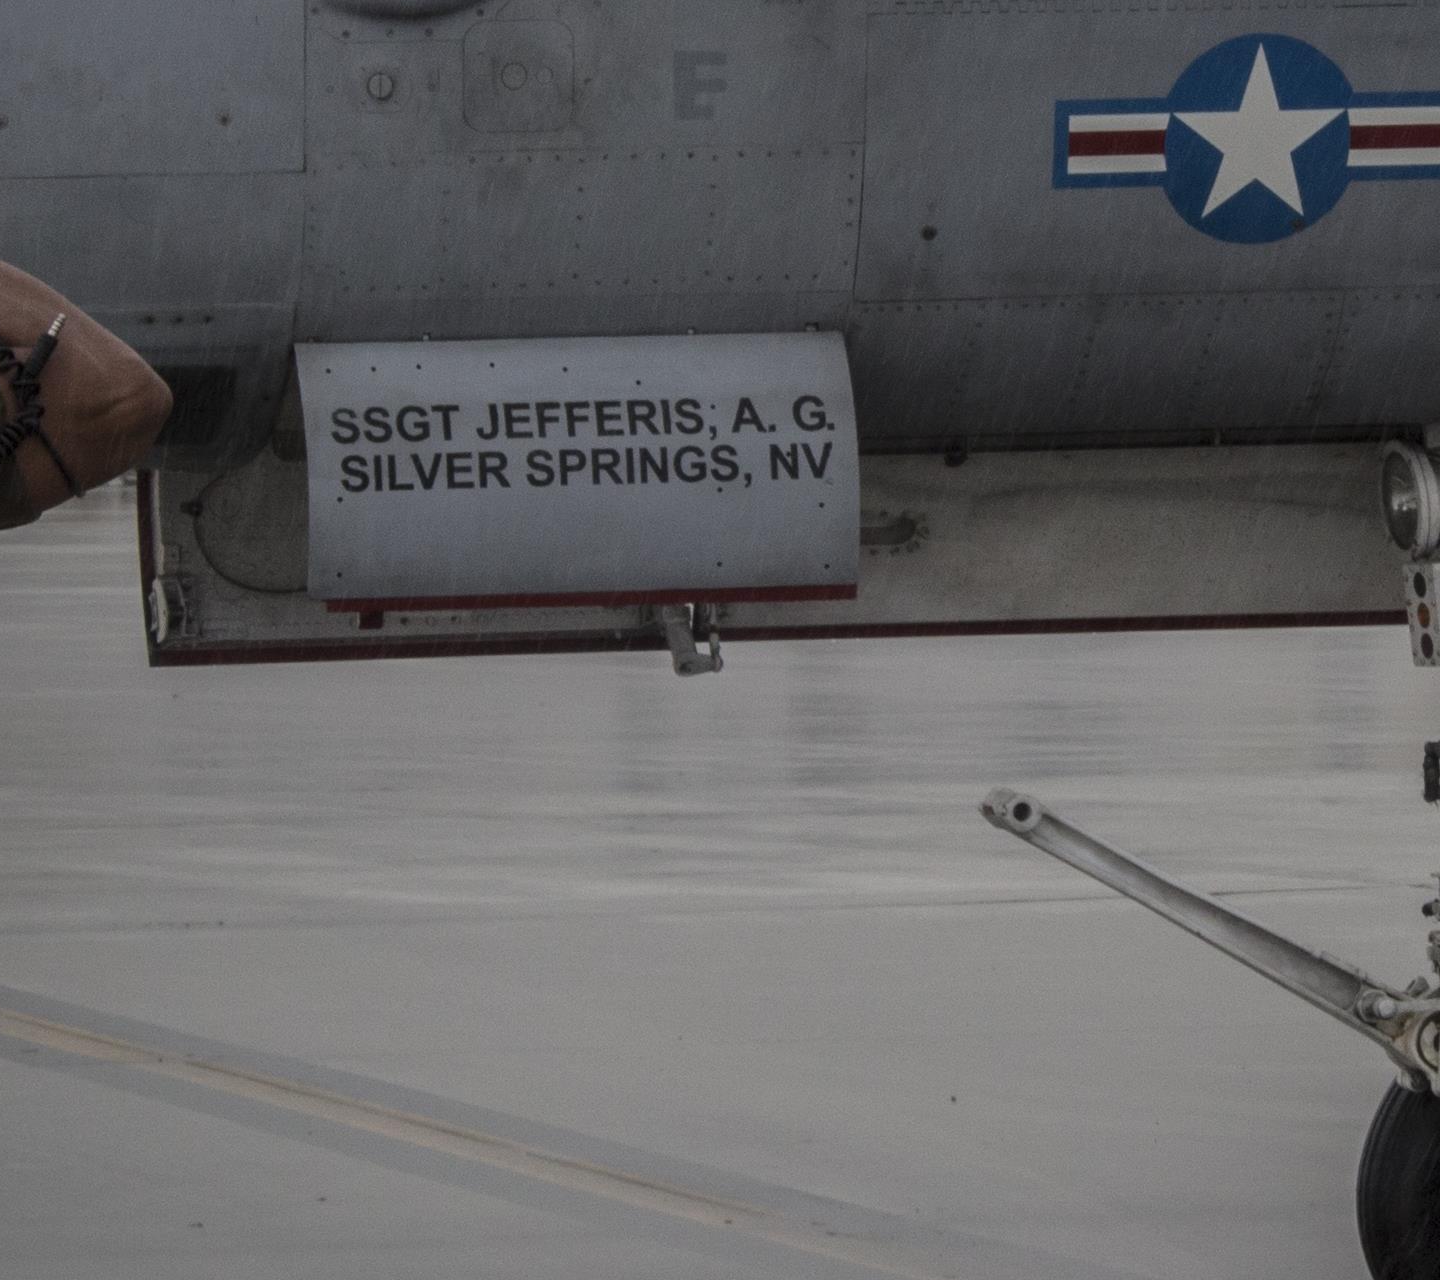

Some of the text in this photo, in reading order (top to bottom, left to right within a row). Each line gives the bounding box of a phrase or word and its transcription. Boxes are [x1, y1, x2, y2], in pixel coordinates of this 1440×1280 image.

[331, 404, 459, 444] SSGT
[732, 397, 776, 433] A.
[792, 395, 835, 431] G.
[340, 441, 833, 492] SILVER SPRINGS, NV
